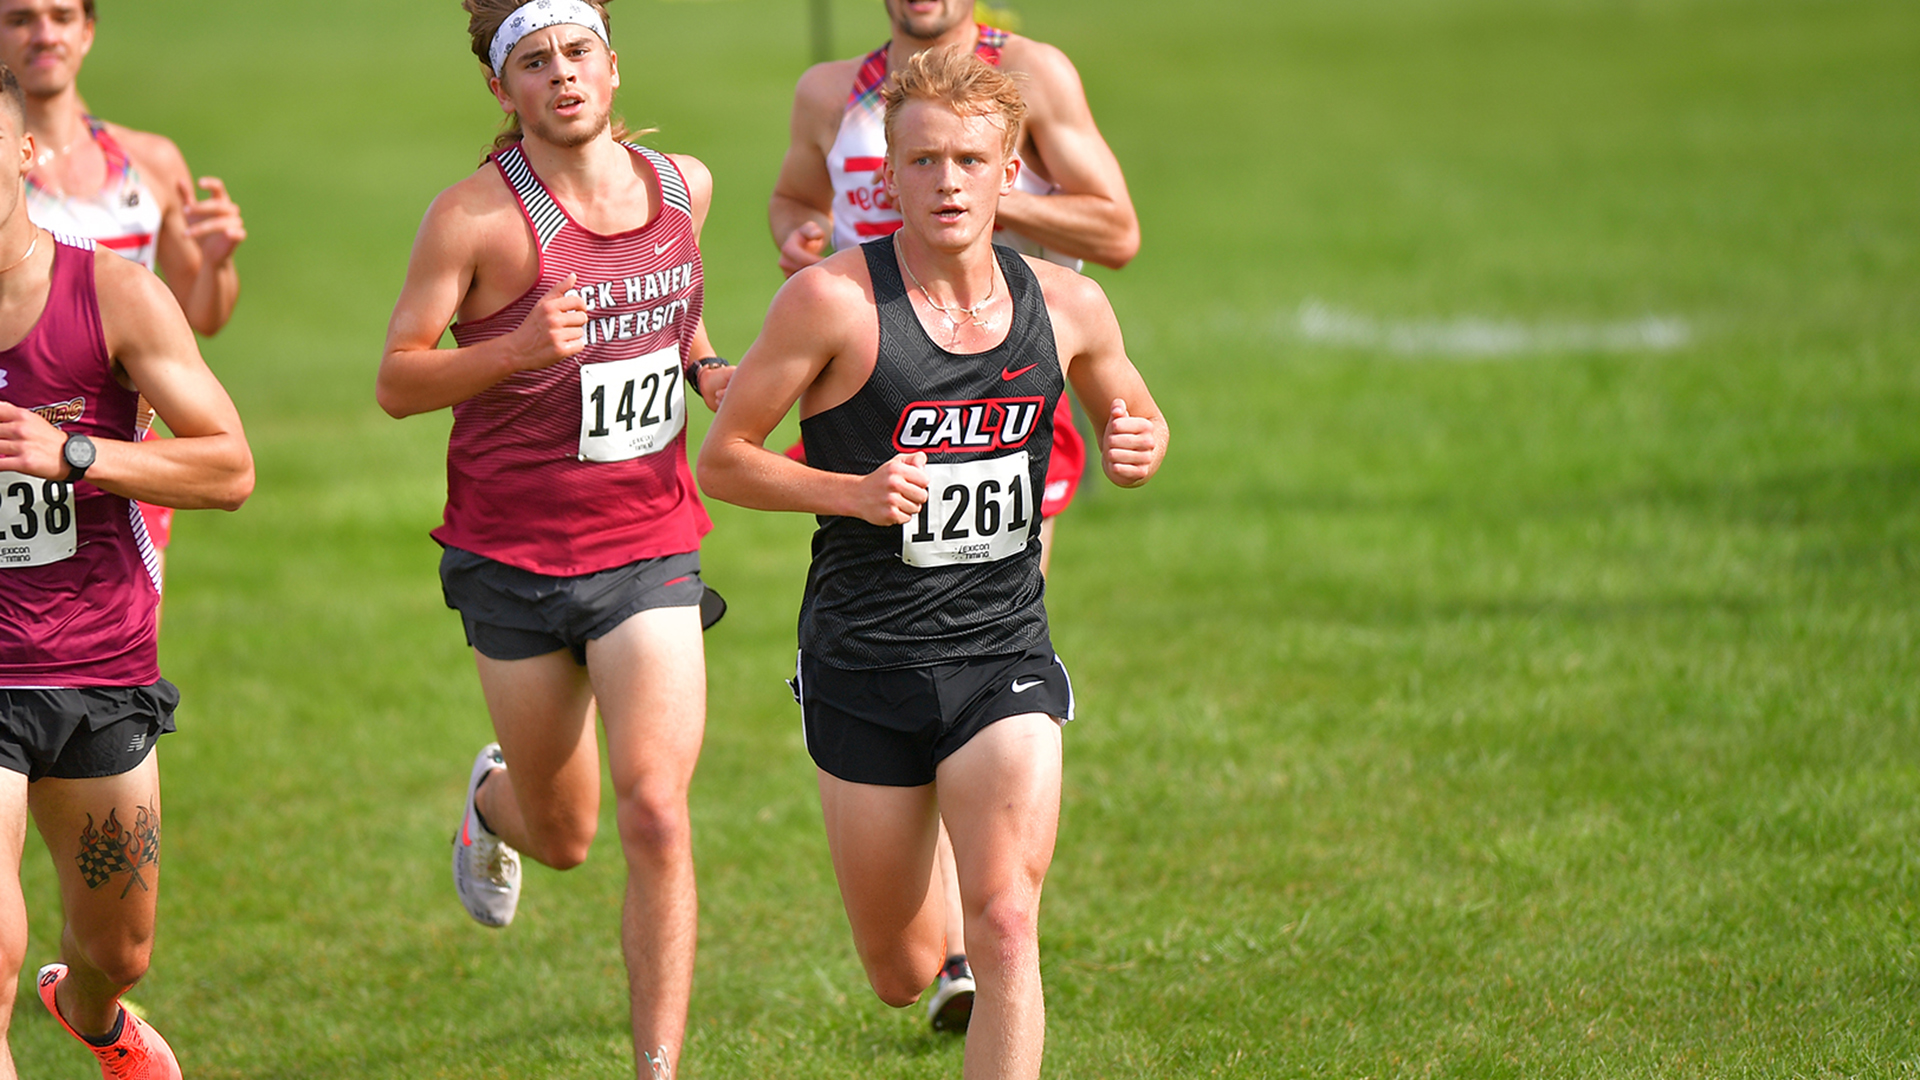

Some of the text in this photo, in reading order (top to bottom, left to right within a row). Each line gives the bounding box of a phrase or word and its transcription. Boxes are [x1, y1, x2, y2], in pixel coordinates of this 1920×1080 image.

[622, 261, 694, 304] HAVEN
[581, 297, 691, 346] IVERSITY
[588, 364, 680, 438] 1427
[0, 479, 72, 540] 38
[911, 474, 1028, 543] 1261
